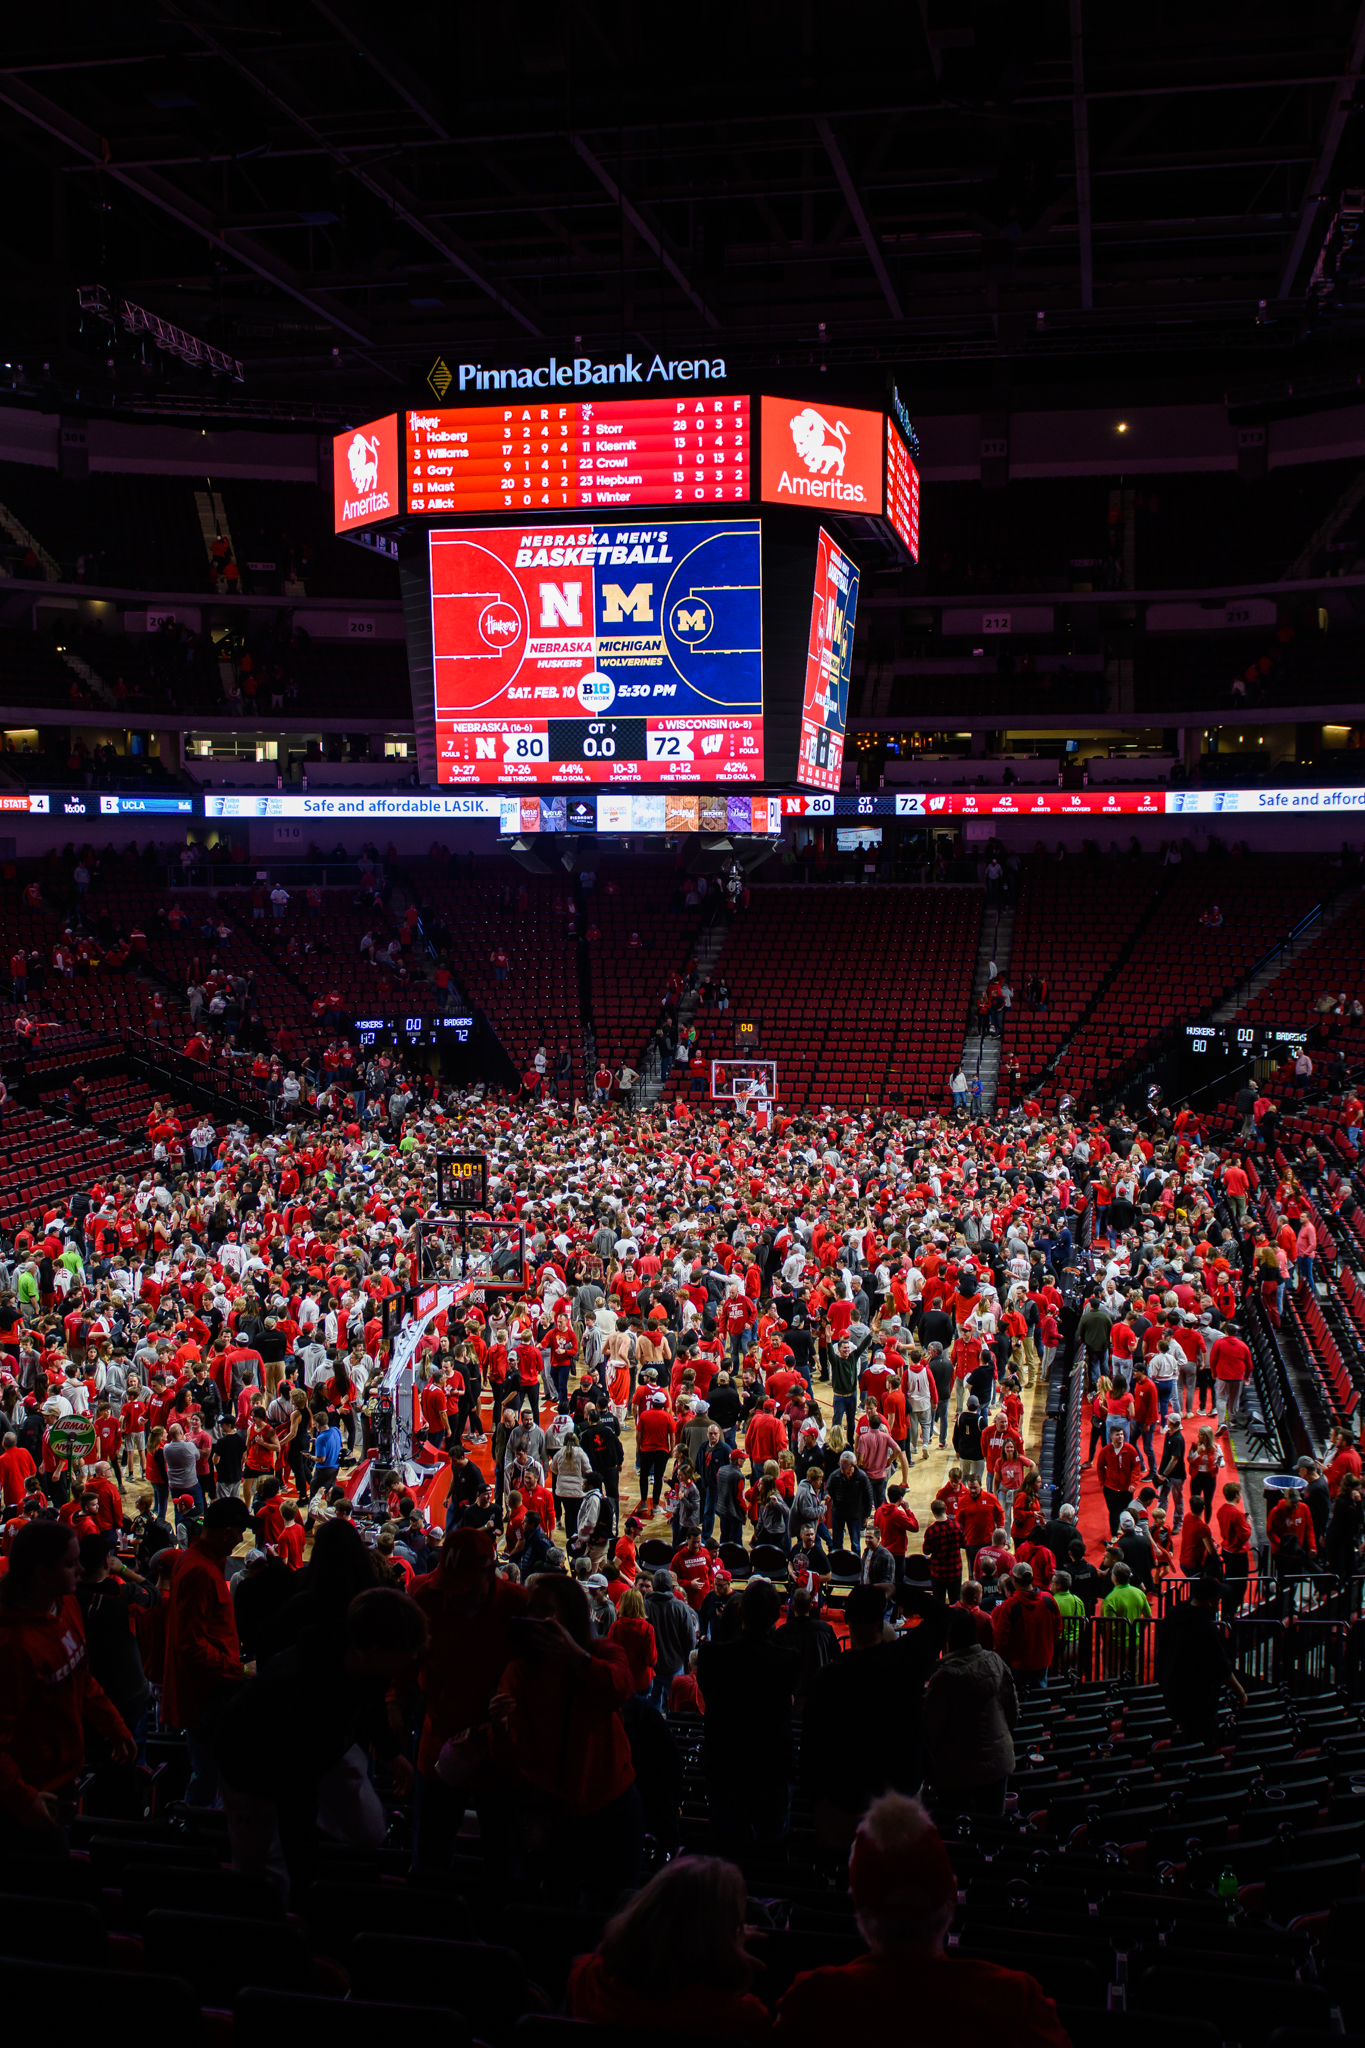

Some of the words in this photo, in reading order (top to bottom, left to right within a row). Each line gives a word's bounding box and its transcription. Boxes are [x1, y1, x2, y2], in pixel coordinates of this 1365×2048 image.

[459, 354, 642, 390] PinnacleBank
[646, 354, 726, 381] Arena
[677, 403, 685, 413] P
[695, 402, 704, 412] A
[715, 402, 722, 411] R
[734, 401, 741, 411] F
[504, 411, 512, 421] P
[522, 410, 531, 420] A
[541, 409, 548, 419] R
[559, 409, 566, 418] F
[582, 425, 589, 435] 2
[596, 424, 623, 434] Storr
[673, 421, 686, 430] 28
[716, 419, 723, 428] 3
[735, 418, 742, 428] 3
[415, 433, 419, 442] 1
[504, 428, 511, 438] 3
[523, 427, 530, 437] 2
[541, 427, 549, 436] 4
[561, 426, 568, 435] 3
[582, 442, 590, 452] 11
[675, 438, 685, 447] 13
[698, 437, 702, 446] 1
[715, 436, 723, 446] 4
[735, 435, 742, 445] 2
[414, 450, 421, 459] 3
[502, 445, 512, 455] 17
[523, 444, 530, 454] 2
[541, 443, 549, 453] 9
[560, 443, 568, 452] 4
[580, 459, 593, 468] 22
[678, 455, 682, 464] 1
[714, 453, 724, 463] 13
[735, 452, 743, 462] 4
[414, 466, 421, 475] 4
[427, 465, 453, 476] Gary
[504, 462, 511, 471] 9
[525, 461, 529, 470] 1
[541, 460, 549, 469] 4
[562, 459, 566, 469] 1
[580, 476, 593, 486] 23
[673, 472, 684, 482] 13
[695, 471, 704, 481] 3
[716, 470, 723, 480] 3
[735, 470, 742, 480] 2
[413, 483, 423, 492] 51
[428, 482, 455, 492] Mast
[501, 479, 515, 488] 20
[524, 478, 531, 487] 3
[542, 477, 549, 487] 8
[561, 477, 568, 486] 2
[777, 470, 864, 502] Ameritas
[582, 493, 592, 503] 31
[597, 492, 630, 502] Winter
[675, 489, 682, 499] 2
[715, 488, 722, 497] 2
[735, 487, 742, 497] 2
[343, 492, 388, 521] Ameritas
[411, 499, 424, 509] 53
[504, 496, 511, 505] 3
[541, 494, 549, 504] 4
[562, 493, 567, 503] 1
[521, 533, 609, 548] NEBRASKA
[616, 531, 668, 544] MEN'S
[515, 545, 673, 569] BASKETBALL
[539, 582, 582, 628] N
[602, 582, 654, 623] M
[678, 609, 705, 631] M
[1228, 611, 1249, 622] 213
[350, 623, 373, 633] 209
[486, 615, 518, 636] Huskers
[986, 618, 1008, 628] 212
[530, 642, 592, 653] NEBRASKA
[598, 640, 661, 652] MICHIGAN
[537, 658, 582, 668] HUSKERS
[600, 657, 663, 667] WOLVERINES
[507, 687, 532, 699] SAT.
[534, 687, 559, 698] FEB.
[562, 686, 575, 697] 10
[617, 685, 650, 697] 5:30
[653, 684, 676, 696] PM
[454, 723, 509, 732] NEBRASKA
[511, 724, 532, 733] (16-6)
[589, 724, 605, 734] OT
[666, 719, 727, 729] WISCONSIN
[729, 721, 751, 729] (16-5)
[447, 741, 454, 750] 7
[582, 738, 615, 756] 0.0
[654, 737, 680, 755] 72
[701, 734, 723, 756] W
[743, 737, 754, 746] 10
[476, 738, 496, 759] N
[517, 739, 543, 756] 80
[452, 765, 475, 774] 9-27
[504, 765, 531, 774] 19-26
[559, 764, 583, 773] 44%
[613, 764, 637, 773] 10-31
[670, 763, 691, 773] 8-12
[724, 763, 747, 772] 42%
[37, 800, 43, 809] 4
[900, 799, 917, 810] 72
[929, 797, 945, 810] W
[965, 798, 975, 806] 10
[999, 797, 1012, 805] 42
[1038, 797, 1044, 805] 8
[1071, 796, 1081, 805] 16
[1108, 796, 1115, 804] 8
[1144, 796, 1150, 804] 2
[1259, 794, 1288, 806] Safe
[1292, 793, 1319, 805] and
[1323, 792, 1365, 805] afford
[64, 804, 86, 813] 16:00
[106, 801, 112, 809] 5
[122, 801, 145, 809] UCLA
[304, 800, 335, 812] Safe
[338, 800, 364, 812] and
[368, 800, 440, 812] affordable
[444, 800, 488, 812] LASIK.
[786, 798, 800, 812] N
[813, 800, 831, 811] 80
[858, 805, 873, 813] 0.0
[277, 828, 299, 837] 110
[456, 1030, 468, 1041] 72
[1186, 1027, 1215, 1036] HUSKERS
[1193, 1040, 1206, 1052] 80
[916, 1379, 920, 1392] 1
[55, 1420, 91, 1430] LIBMAN
[1006, 1470, 1014, 1478] N
